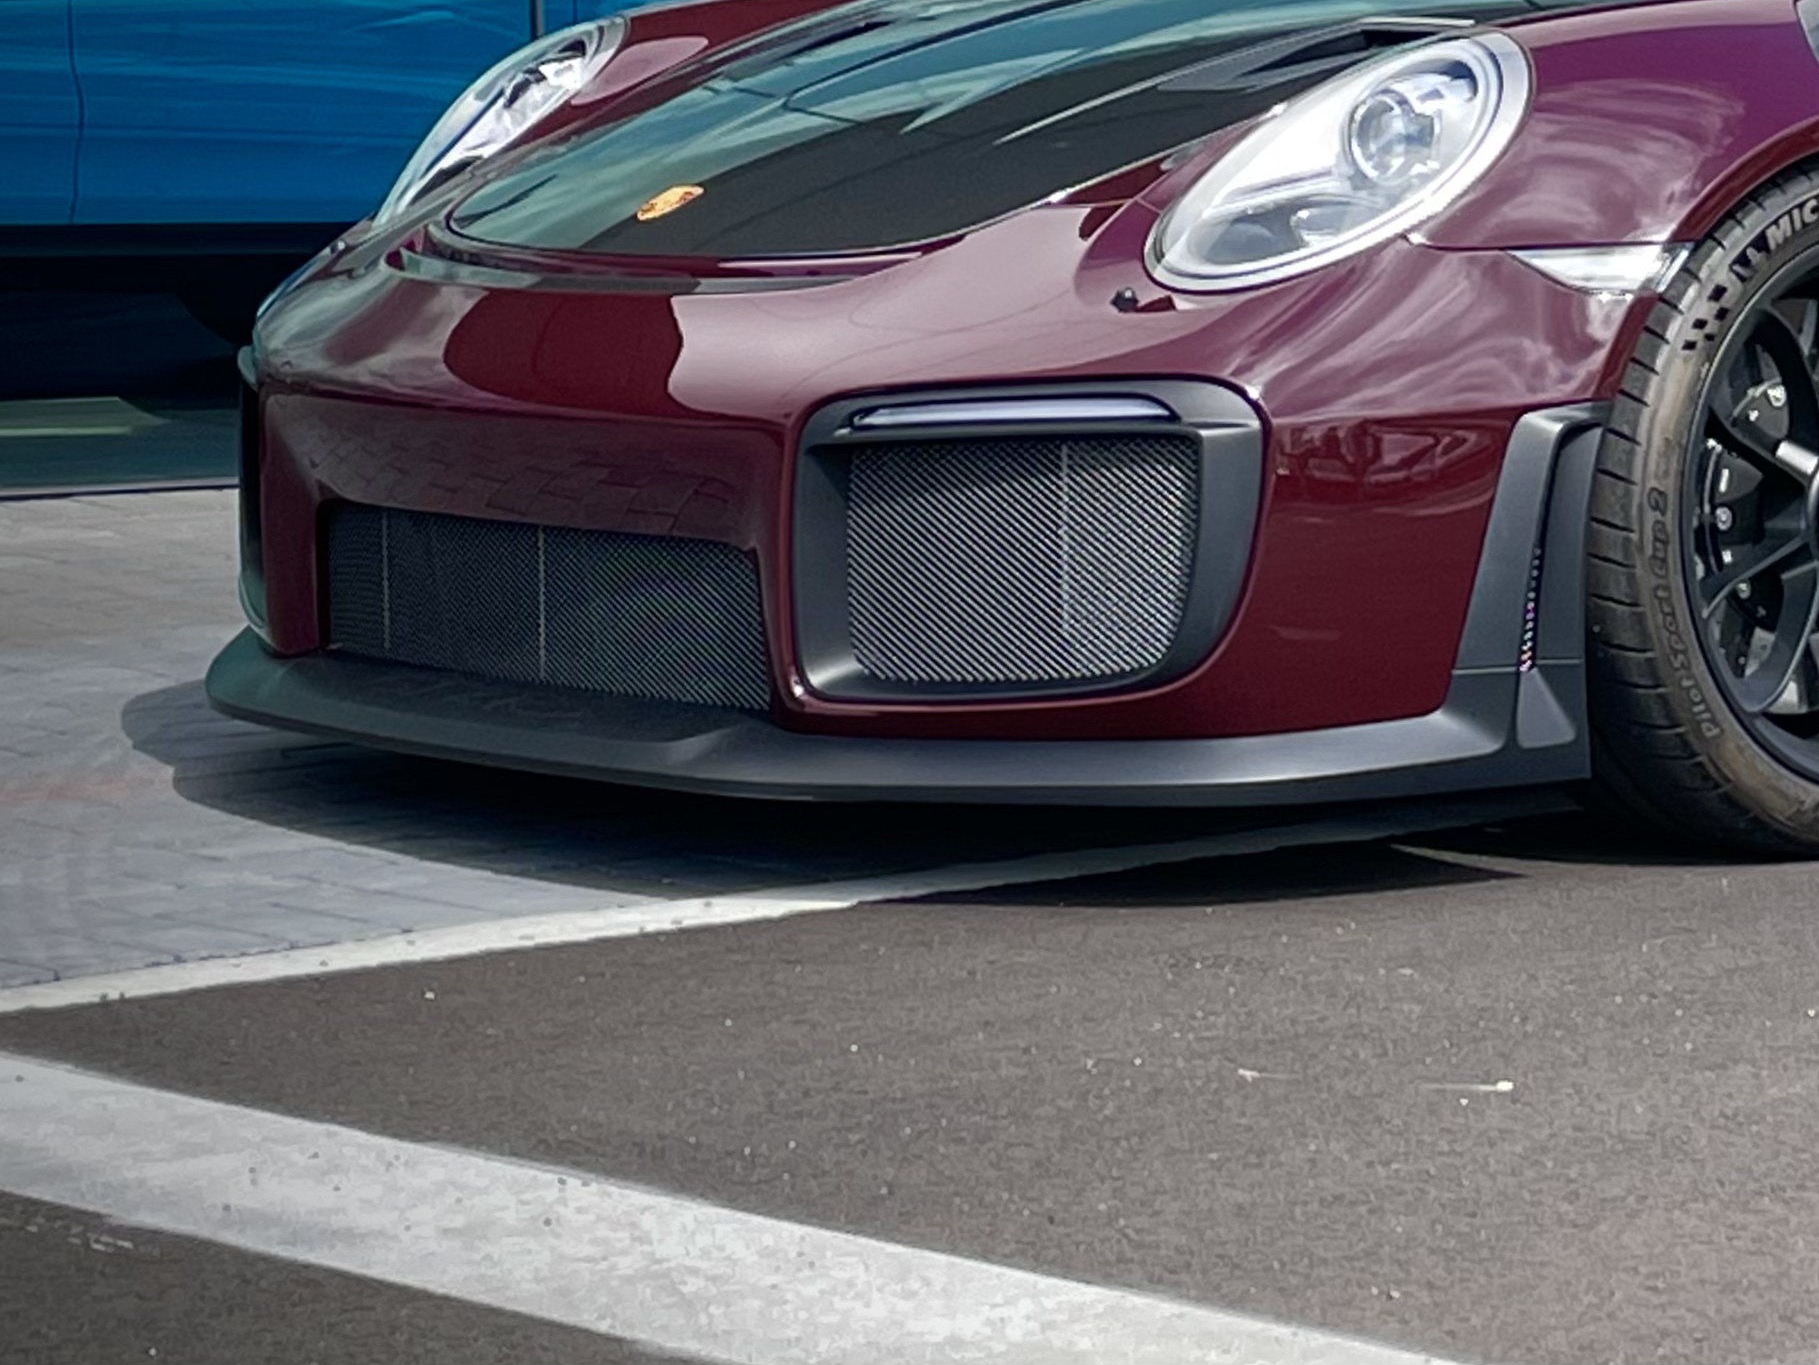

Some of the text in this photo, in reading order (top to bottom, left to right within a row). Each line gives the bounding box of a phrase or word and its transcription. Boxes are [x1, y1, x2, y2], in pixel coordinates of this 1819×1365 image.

[1647, 487, 1668, 517] 2
[1654, 585, 1690, 671] Sport
[1680, 677, 1723, 738] Pilot
